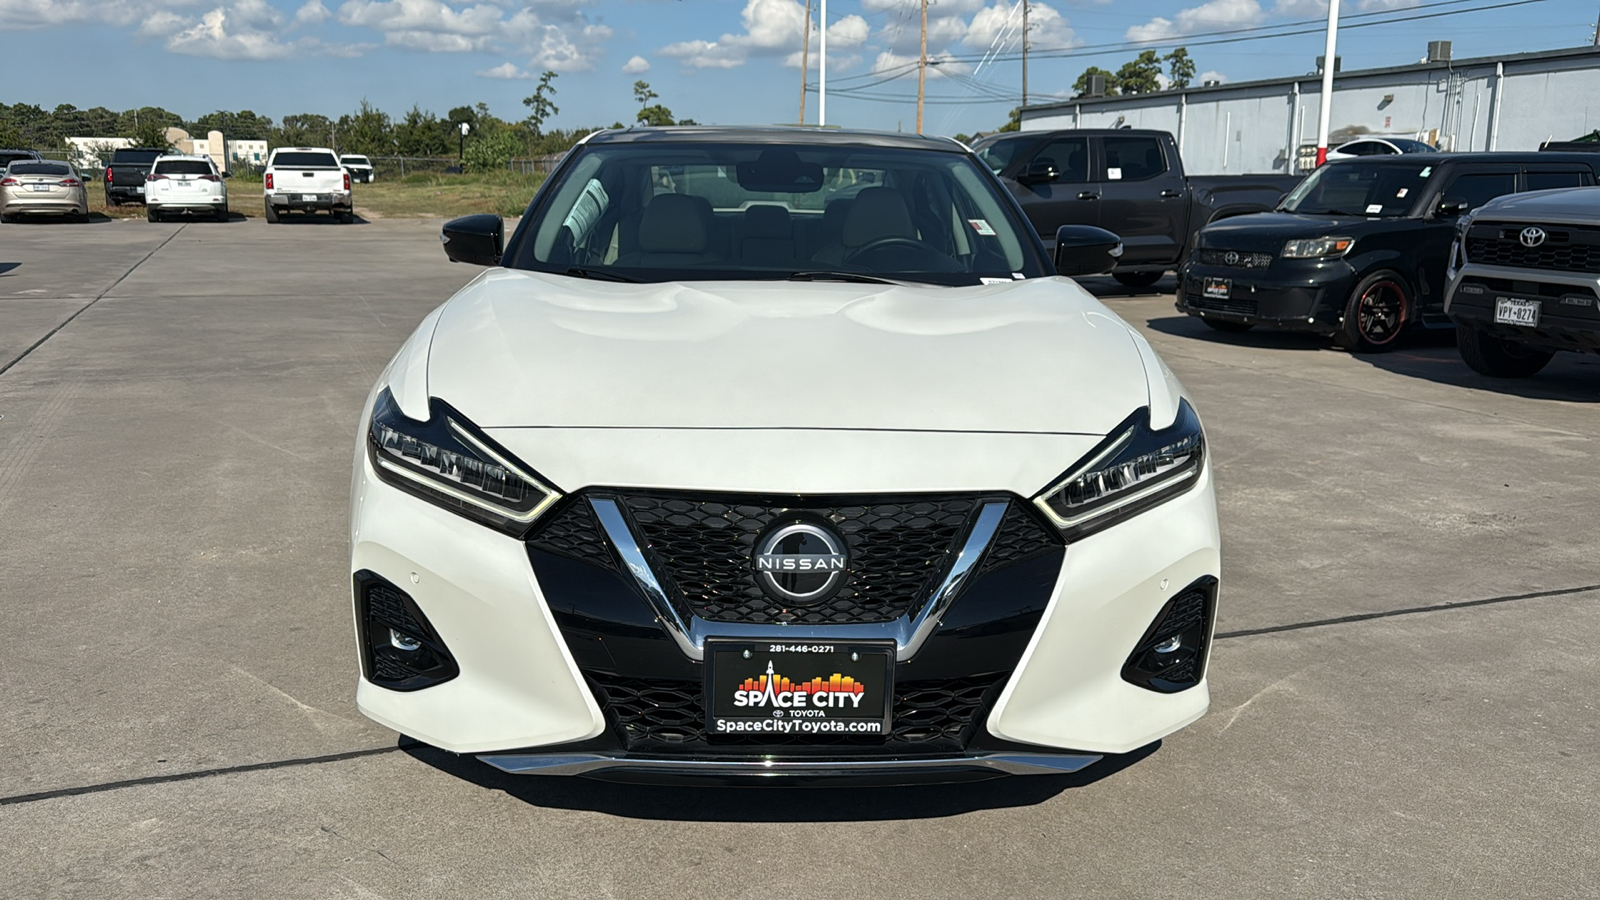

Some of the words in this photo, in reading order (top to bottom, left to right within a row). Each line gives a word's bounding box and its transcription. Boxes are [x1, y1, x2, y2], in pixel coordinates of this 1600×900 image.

[758, 557, 844, 570] NISSAN
[770, 645, 834, 653] 281-446-0271
[734, 690, 807, 707] SPACE
[812, 692, 865, 708] CITY
[789, 710, 826, 718] TOYOTA
[716, 719, 881, 733] SpaceCityToyota.com
